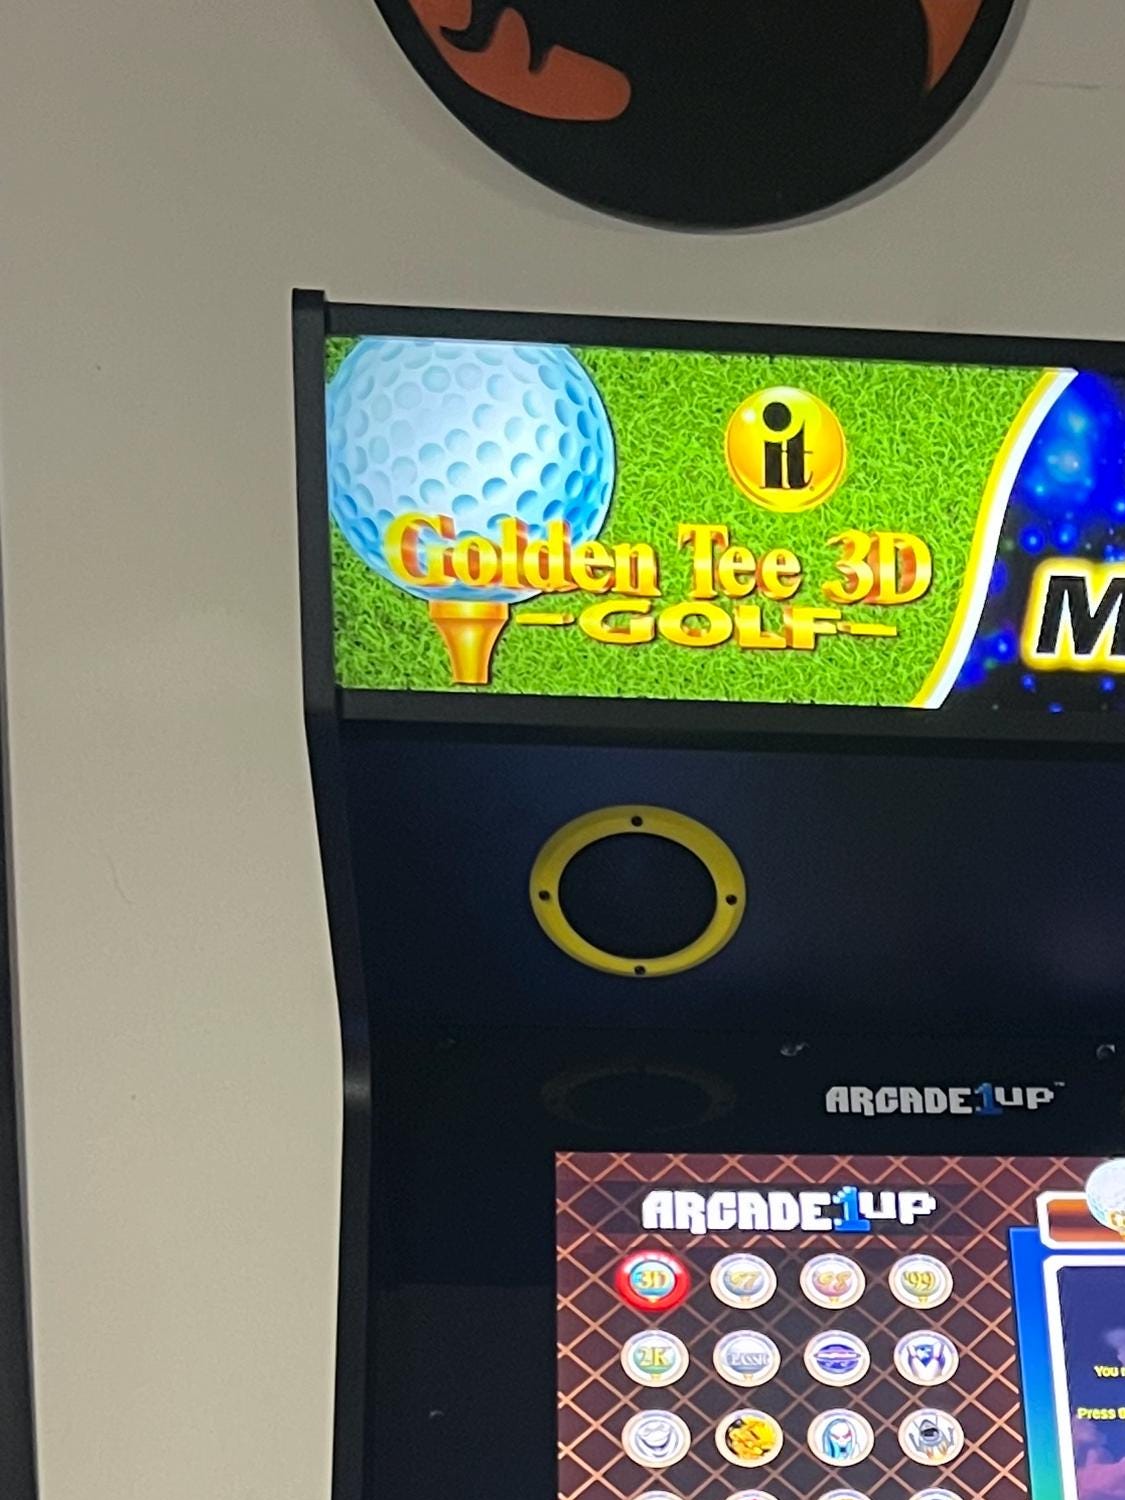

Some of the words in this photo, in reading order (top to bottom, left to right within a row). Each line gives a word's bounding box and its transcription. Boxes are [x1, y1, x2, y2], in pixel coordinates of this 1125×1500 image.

[384, 511, 661, 596] Golden
[677, 523, 801, 598] Tee
[822, 529, 933, 606] 3D
[577, 599, 843, 650] GOLF
[641, 1186, 936, 1234] ARCADE1UP
[1077, 1408, 1116, 1419] Press
